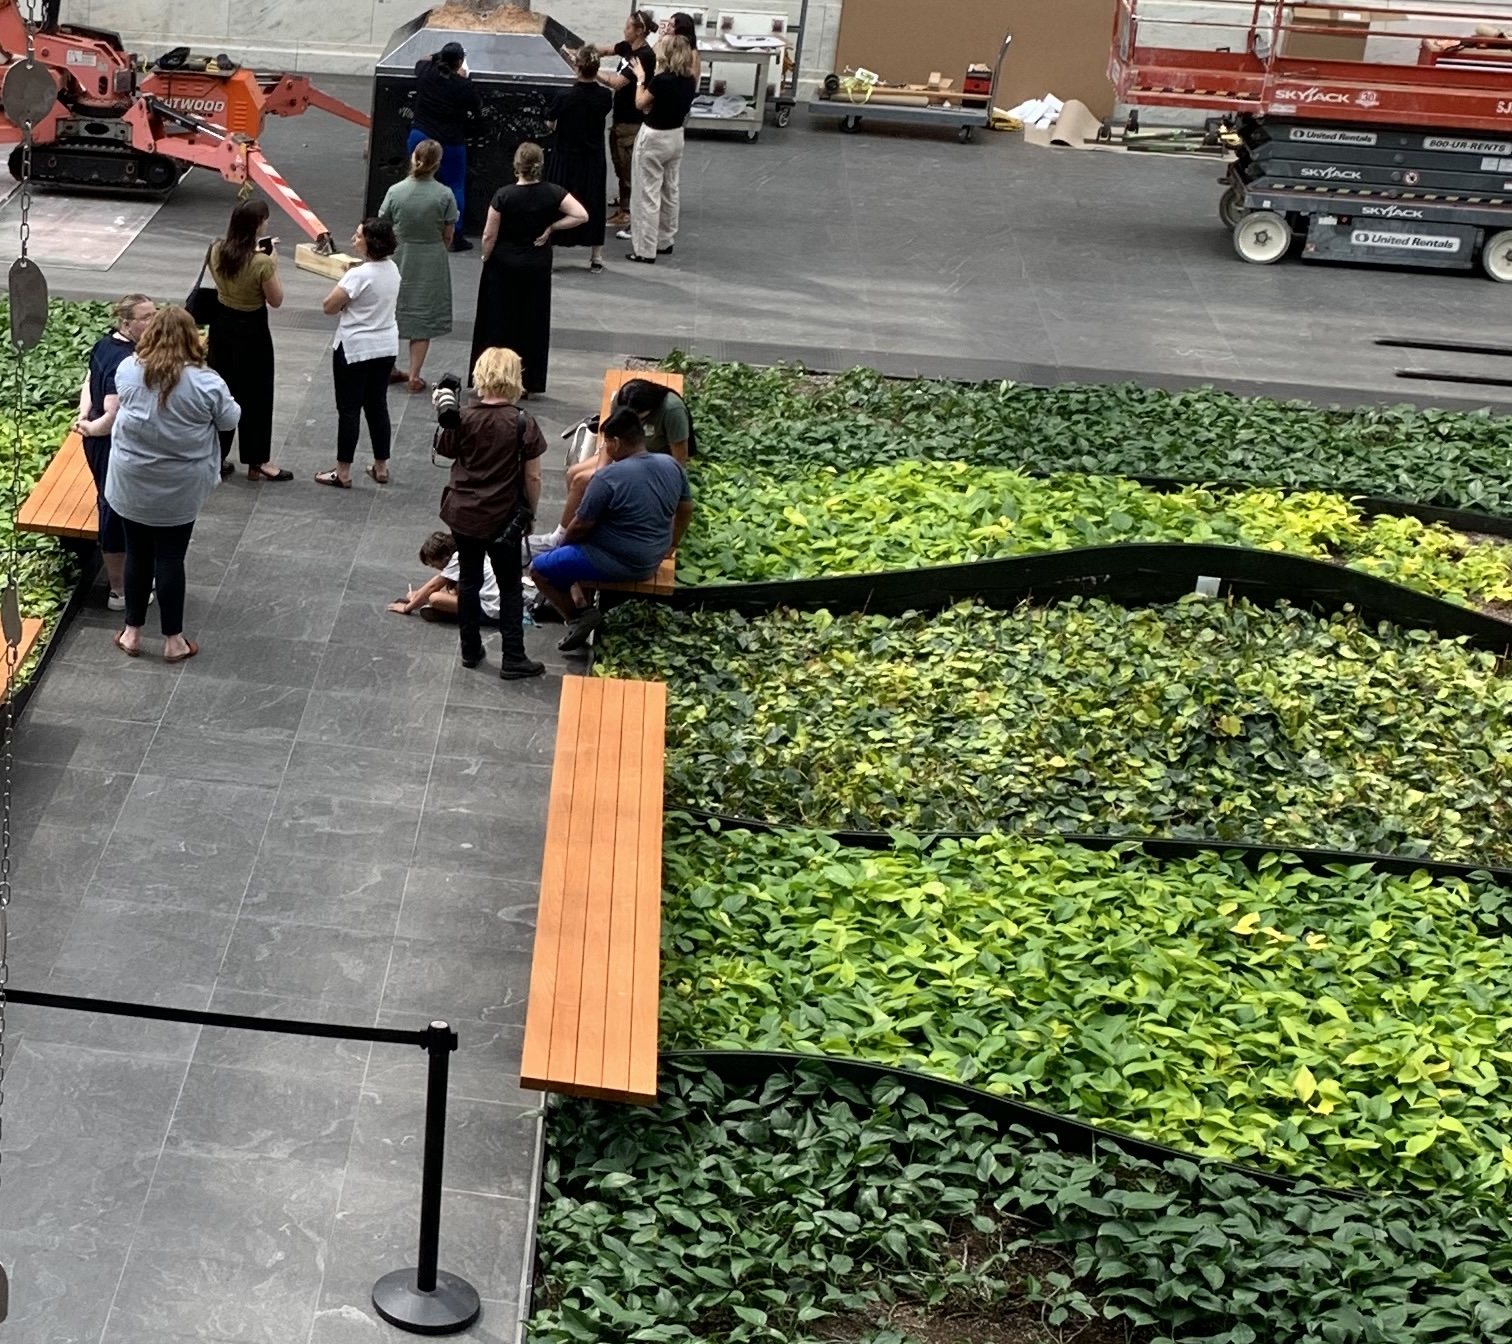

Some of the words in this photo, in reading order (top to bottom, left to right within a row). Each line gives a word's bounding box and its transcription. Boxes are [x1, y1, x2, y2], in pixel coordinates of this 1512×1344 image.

[1275, 87, 1350, 103] SKYJACK
[1306, 131, 1337, 141] United
[1338, 132, 1373, 144] Rentals
[1300, 167, 1362, 180] SKYJACK
[1361, 205, 1423, 218] SKYJACK
[1371, 235, 1410, 246] United
[1411, 237, 1454, 249] Rentals
